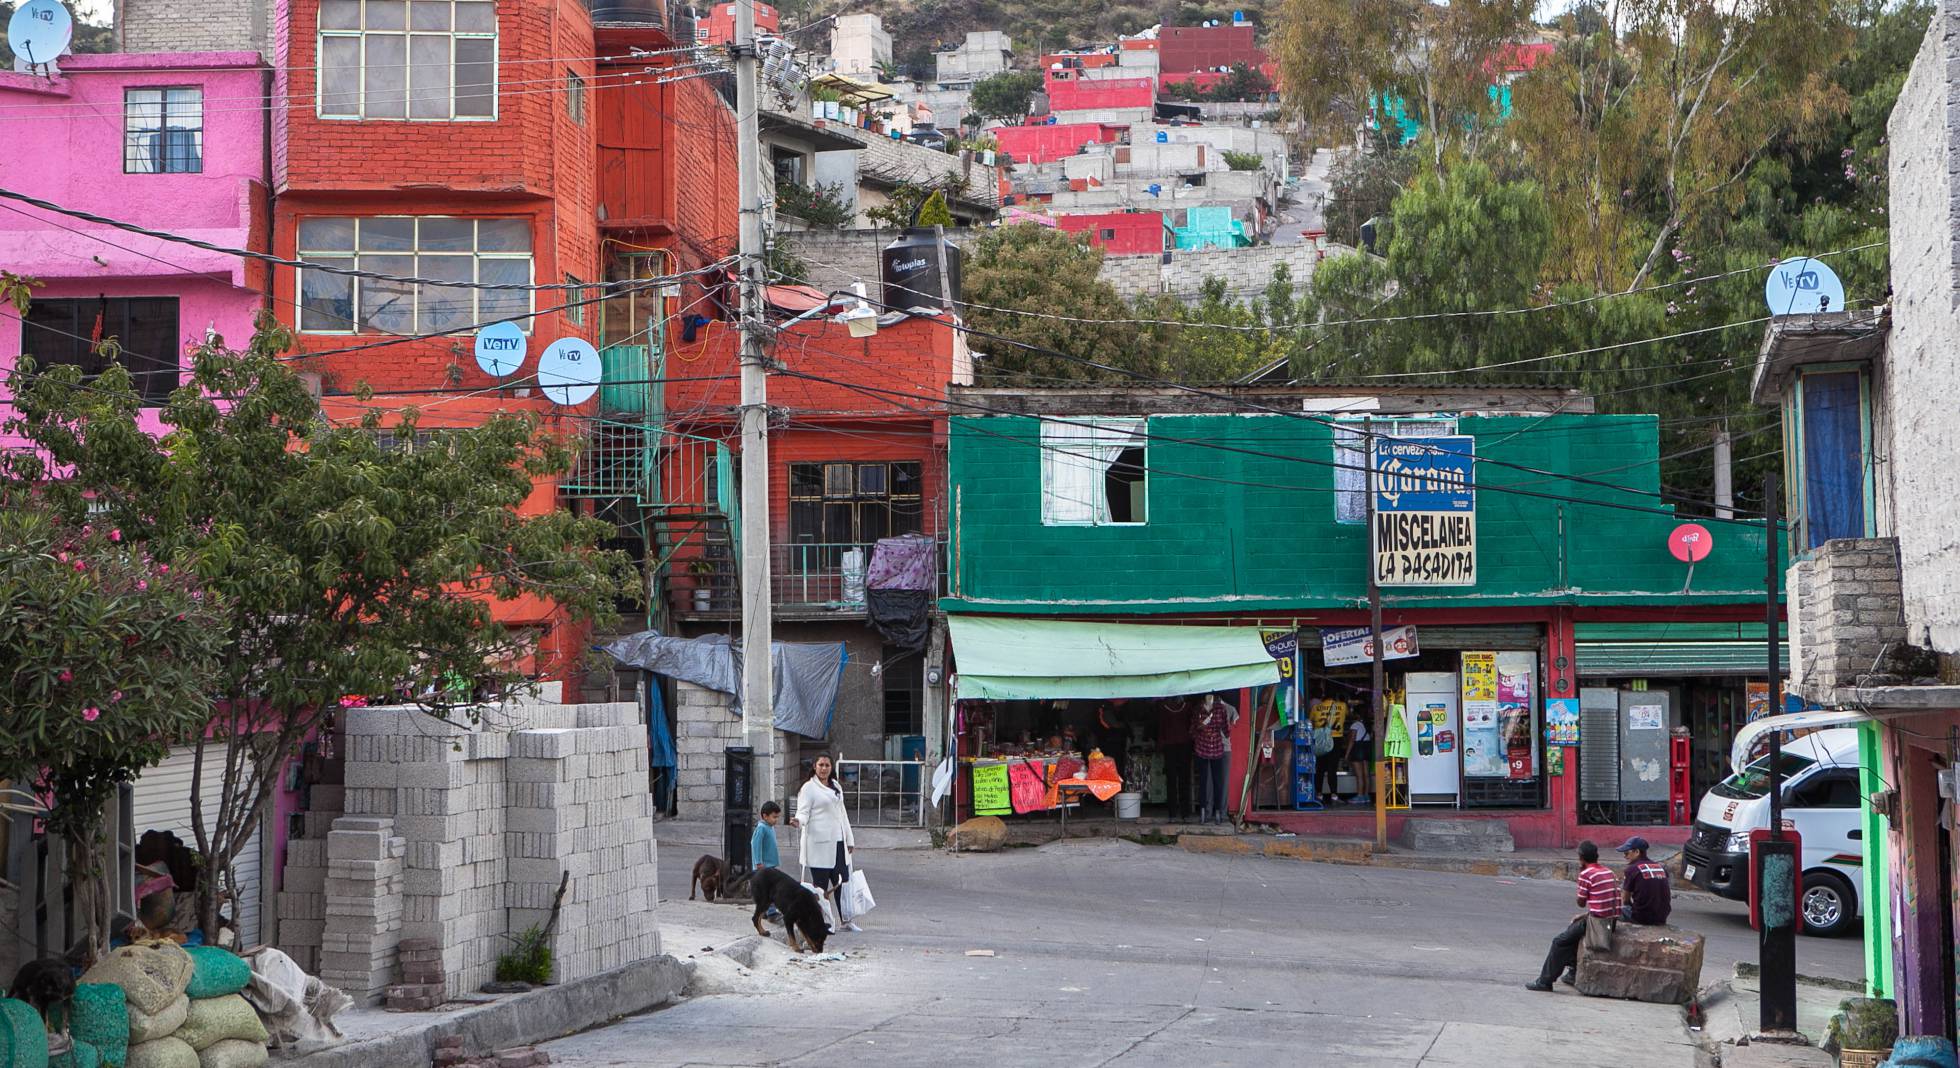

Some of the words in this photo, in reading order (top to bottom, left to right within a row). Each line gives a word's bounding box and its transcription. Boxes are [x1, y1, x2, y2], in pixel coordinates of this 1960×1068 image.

[484, 338, 519, 350] VeTV
[1378, 458, 1467, 508] Corona
[1377, 513, 1473, 553] MISCELANEA
[1378, 552, 1396, 582] LA
[1401, 551, 1473, 583] PASADITA
[1322, 627, 1370, 646] ¡OFERTA!
